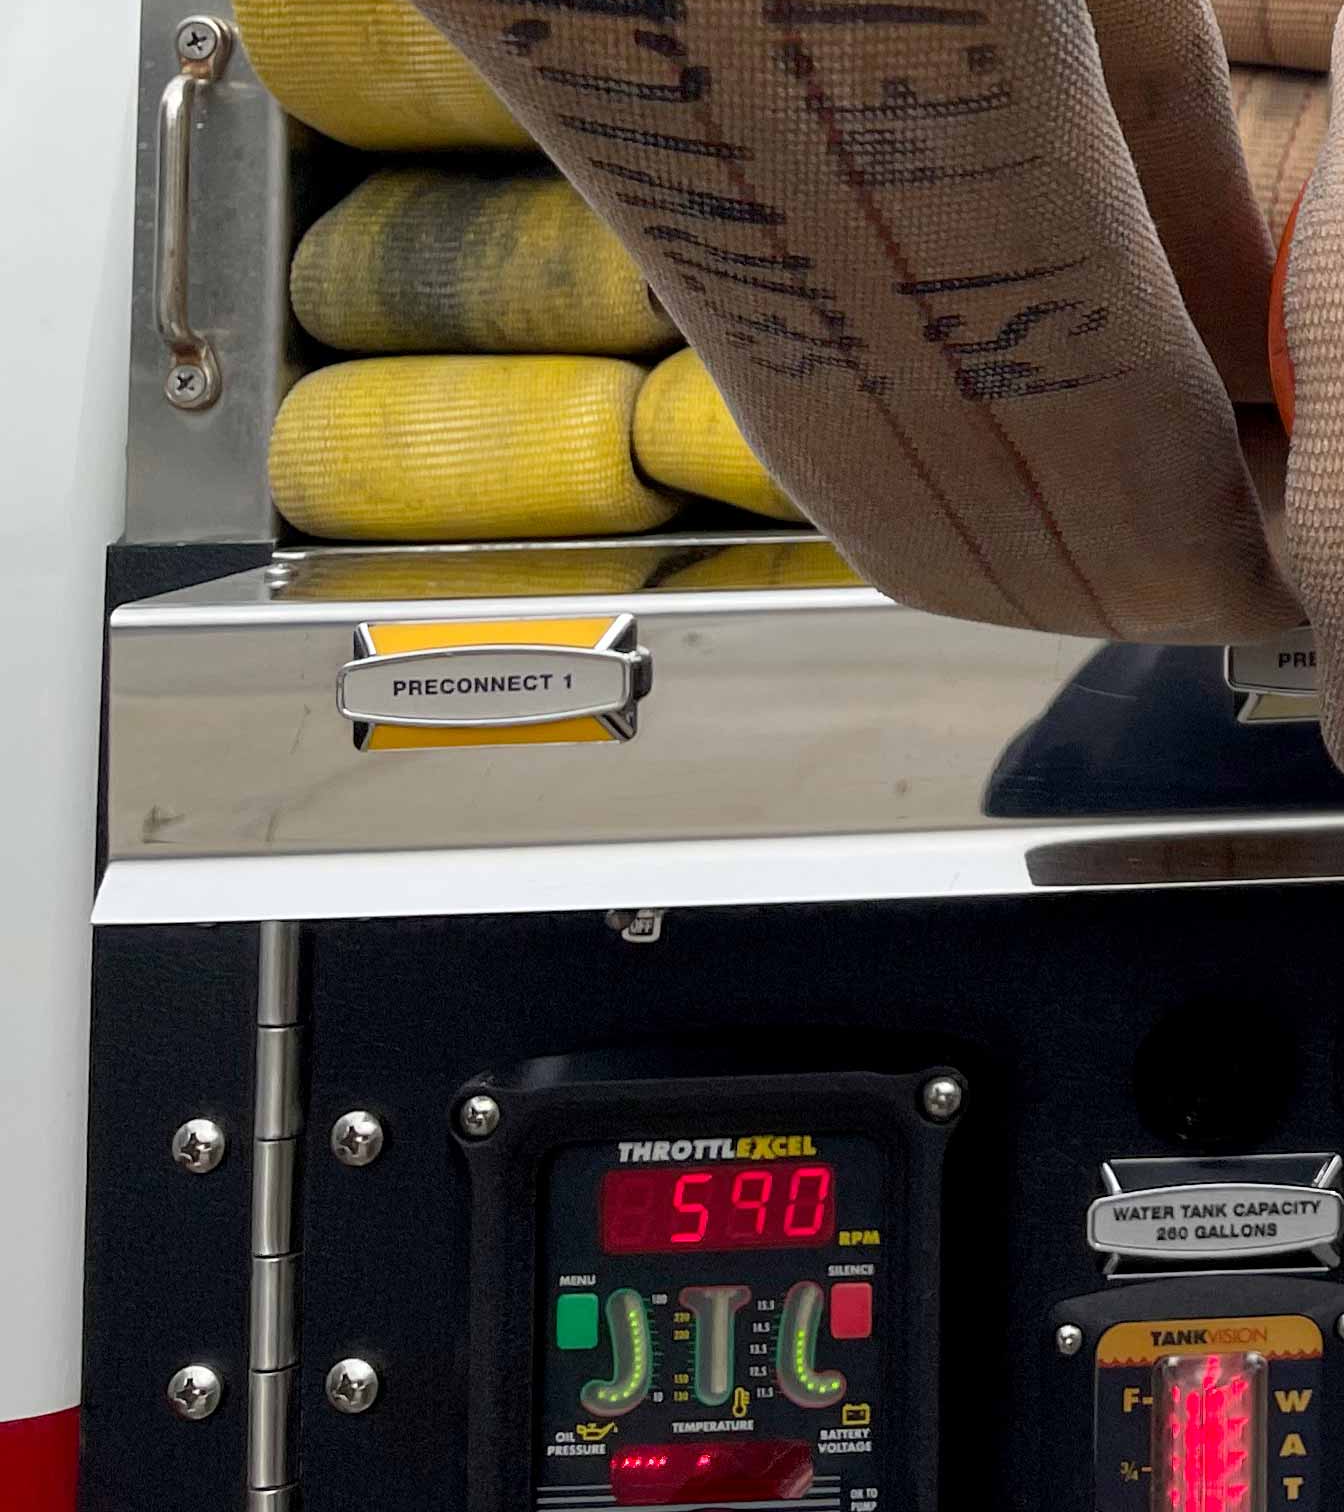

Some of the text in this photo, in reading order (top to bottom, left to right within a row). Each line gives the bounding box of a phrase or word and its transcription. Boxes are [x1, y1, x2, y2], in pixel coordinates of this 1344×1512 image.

[393, 674, 572, 696] PRECONNECT 1
[671, 1167, 831, 1243] 590
[1113, 1200, 1322, 1221] WATER TANK CAPACITY
[839, 1229, 880, 1246] RPM
[1157, 1222, 1277, 1241] 260 GALLONS
[828, 1264, 875, 1277] SILENCE
[559, 1274, 597, 1287] MENU
[672, 1419, 754, 1433] TEMPERATURE
[555, 1431, 575, 1444] OIL
[819, 1428, 871, 1441] BATTERY
[546, 1443, 607, 1456] PRESSURE
[818, 1441, 872, 1454] VOLTAGE
